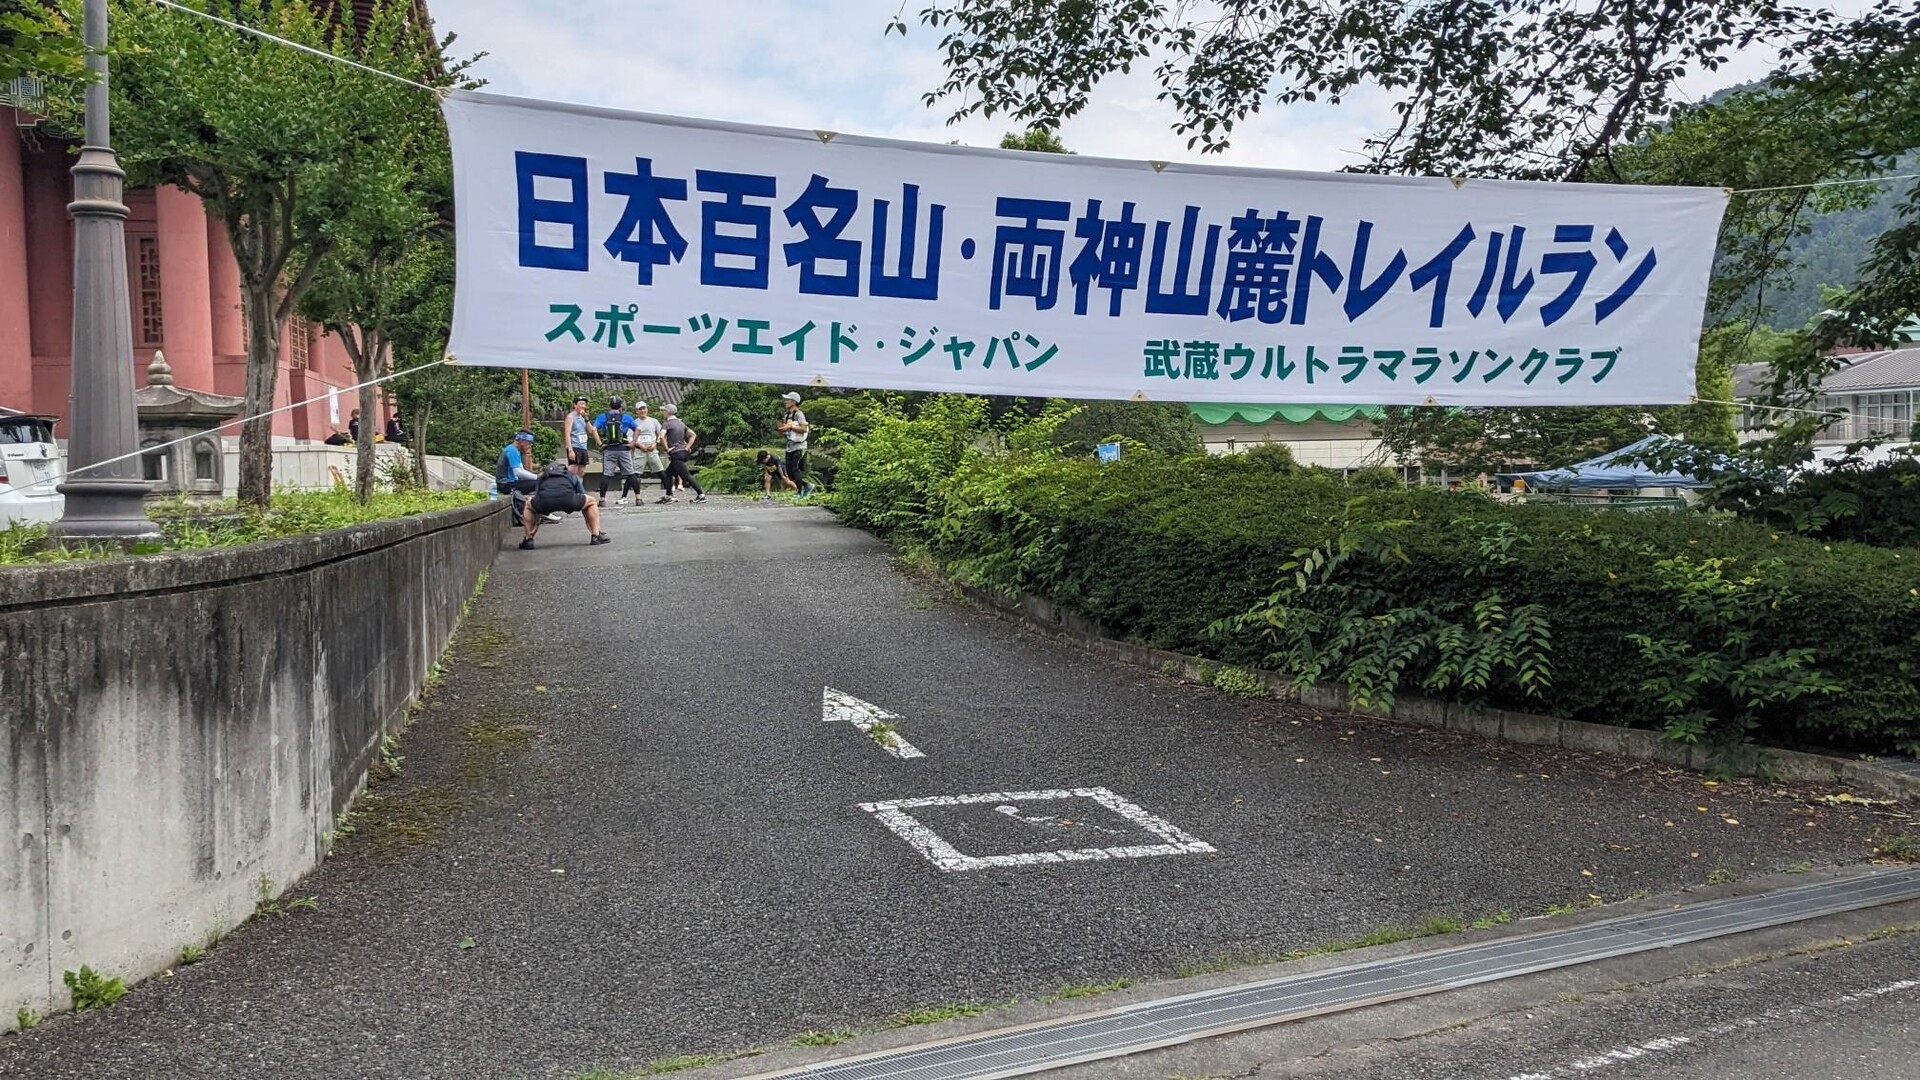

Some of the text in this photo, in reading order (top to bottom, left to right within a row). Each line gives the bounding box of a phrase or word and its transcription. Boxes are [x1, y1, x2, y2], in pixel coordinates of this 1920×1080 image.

[544, 303, 1621, 385] スポーツエイド・ジャパン 武蔵ウルトラマラソンクラブ
